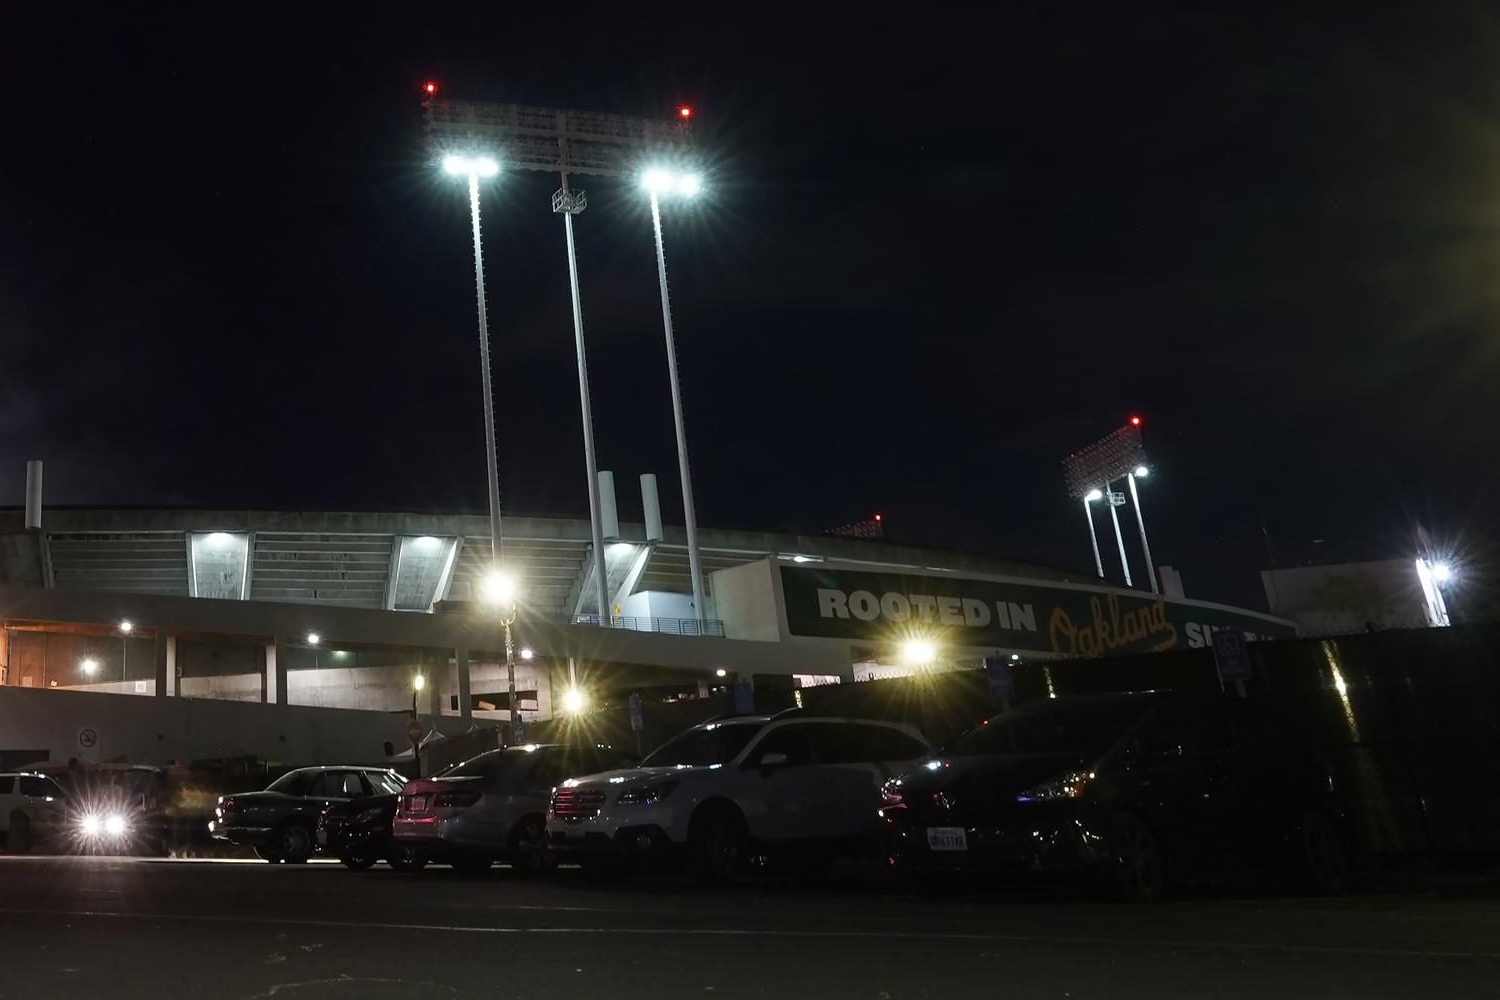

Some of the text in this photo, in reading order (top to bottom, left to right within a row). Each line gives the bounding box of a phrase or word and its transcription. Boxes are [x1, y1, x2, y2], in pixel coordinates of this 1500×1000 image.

[817, 588, 991, 627] ROOTED
[996, 601, 1037, 632] IN
[1050, 591, 1177, 655] Oakland
